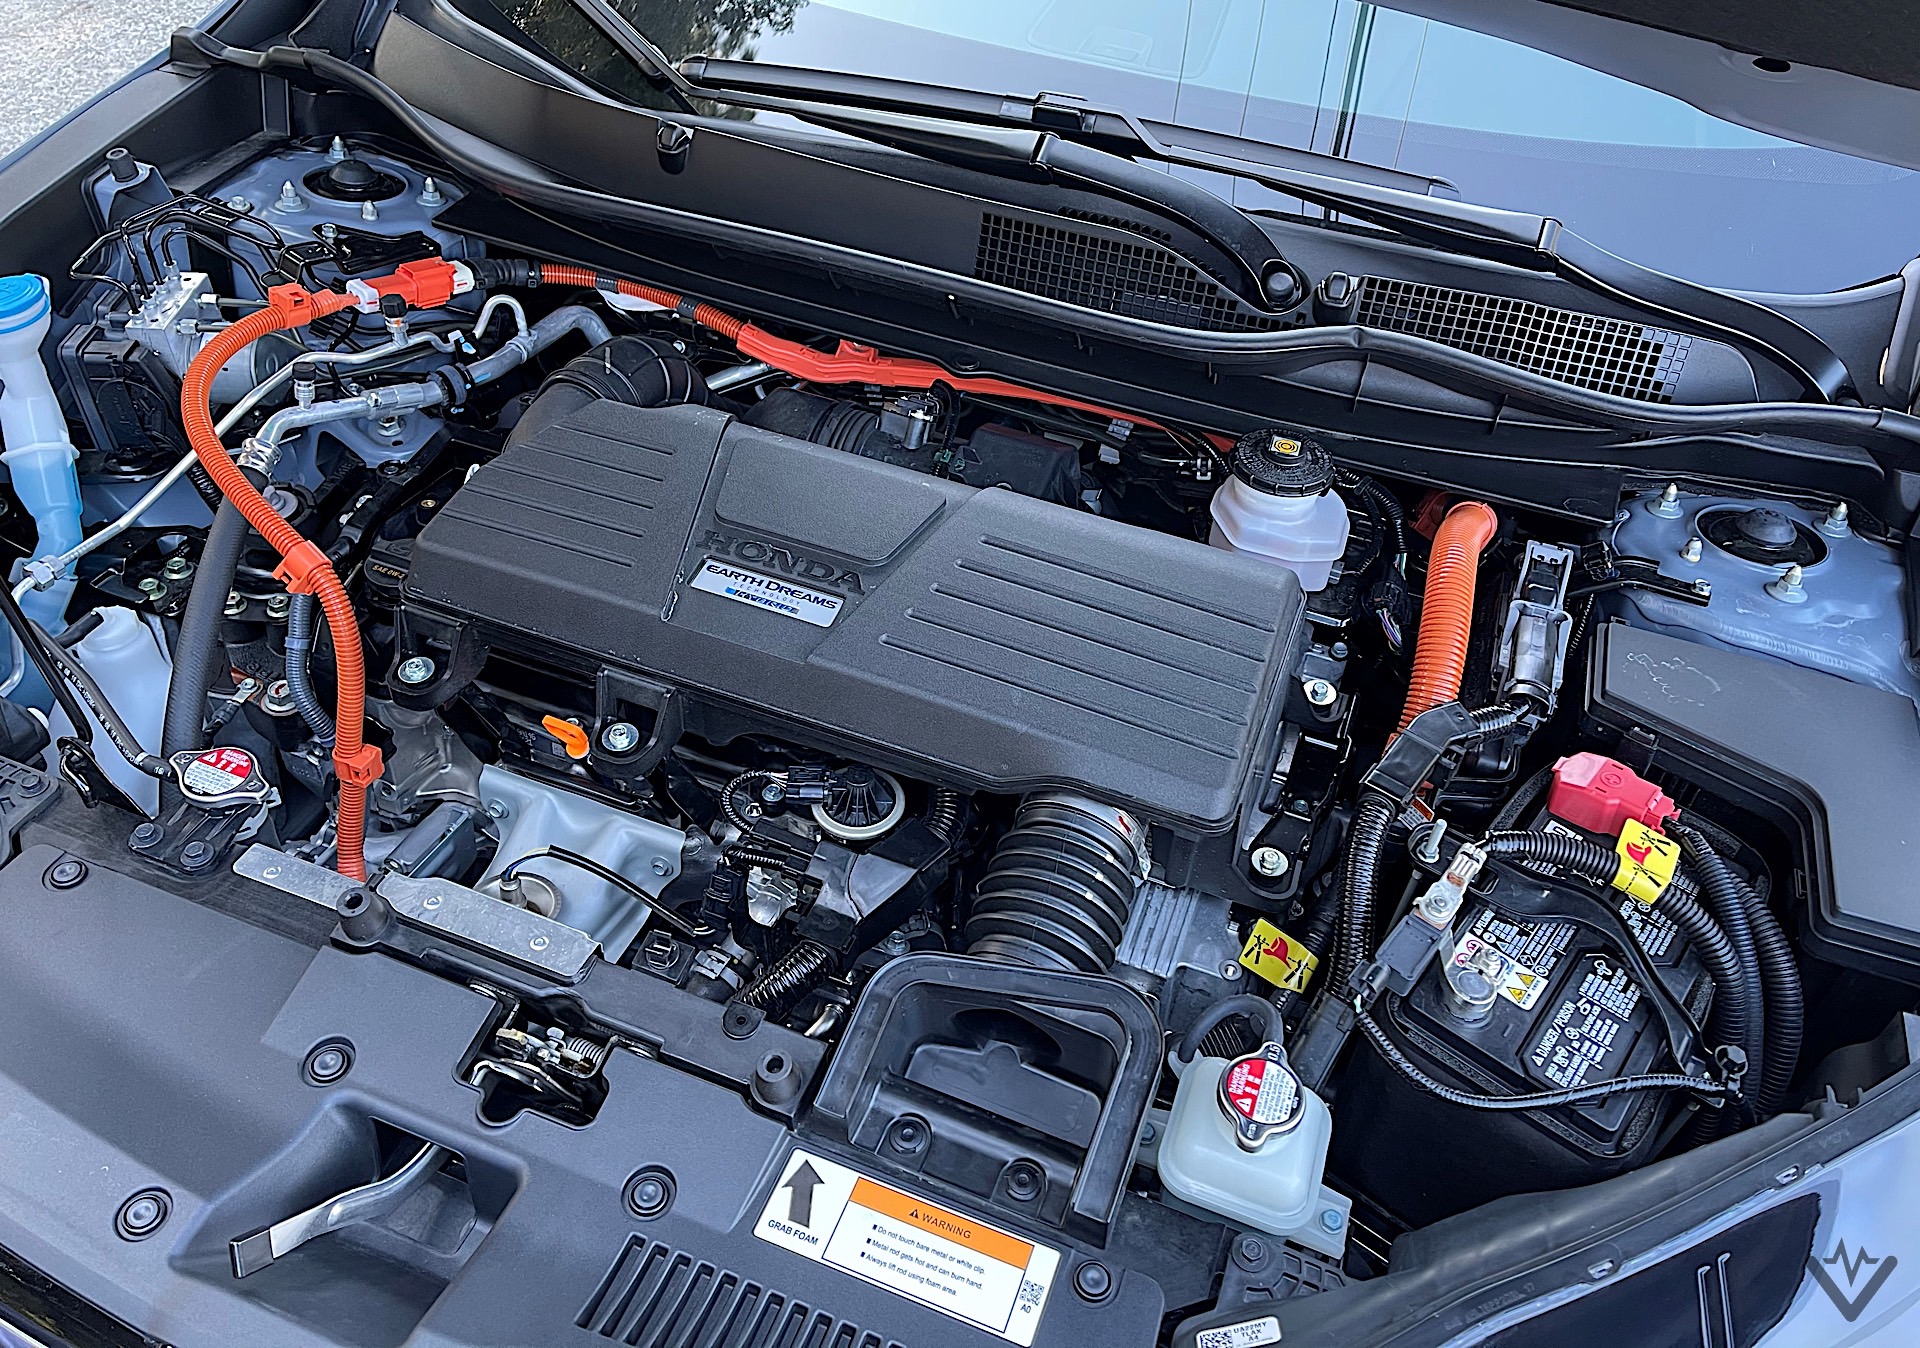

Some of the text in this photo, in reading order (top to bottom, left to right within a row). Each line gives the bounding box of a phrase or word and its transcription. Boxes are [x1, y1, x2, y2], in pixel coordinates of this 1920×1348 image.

[372, 564, 388, 574] SAE
[696, 530, 865, 595] HONDA
[706, 564, 764, 587] EARTH
[765, 580, 838, 609] DREAMS
[733, 581, 800, 606] TECHNOLOGY
[768, 1219, 819, 1245] GRAB FOAM
[922, 1213, 972, 1239] WARNING
[878, 1226, 887, 1235] Do
[888, 1231, 898, 1239] not
[898, 1235, 915, 1246] touch
[915, 1242, 930, 1252] bare
[931, 1248, 948, 1259] metal
[956, 1259, 973, 1269] white
[973, 1265, 985, 1275] clip.
[865, 1254, 957, 1296] Always lift rod using foam area.
[872, 1239, 983, 1290] Metal rod gets hot and can burn hand.
[1233, 1321, 1267, 1334] UA22MY
[1241, 1329, 1262, 1338] TLAX
